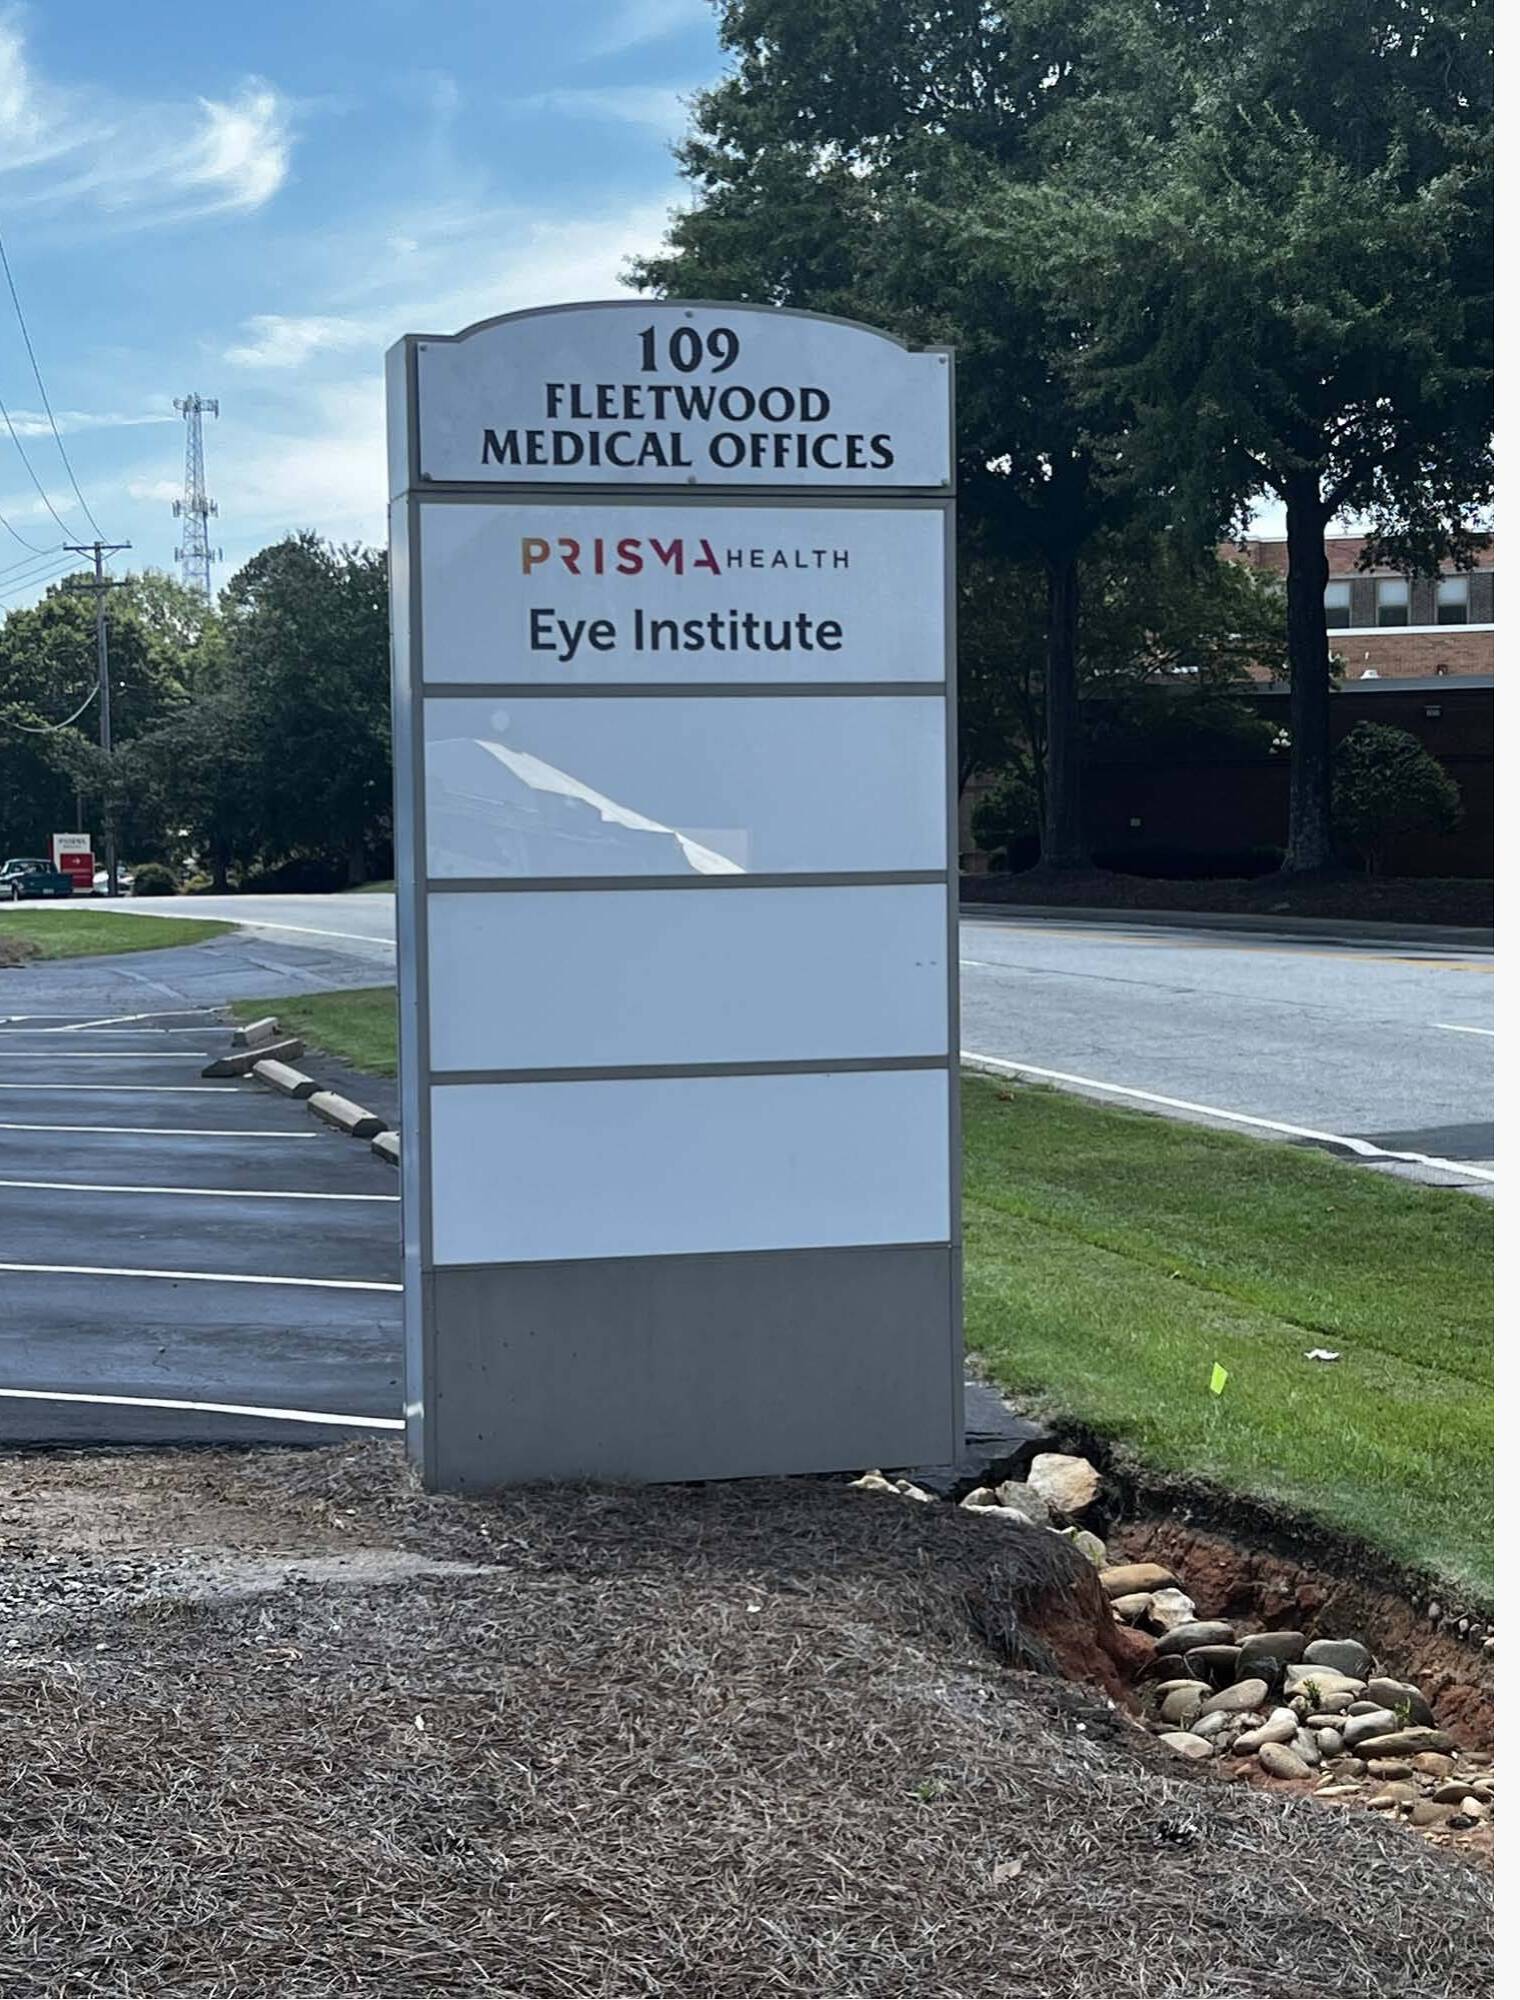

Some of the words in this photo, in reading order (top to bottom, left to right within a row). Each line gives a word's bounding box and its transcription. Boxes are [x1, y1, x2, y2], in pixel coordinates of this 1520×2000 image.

[638, 326, 740, 374] 109
[546, 383, 831, 422] FLEETWOOD
[482, 429, 693, 468] MEDICAL
[709, 432, 895, 470] OFFICES
[522, 538, 721, 576] PRISMA
[726, 549, 849, 569] HEALTH
[530, 608, 616, 662] Eye
[634, 609, 843, 652] Institute
